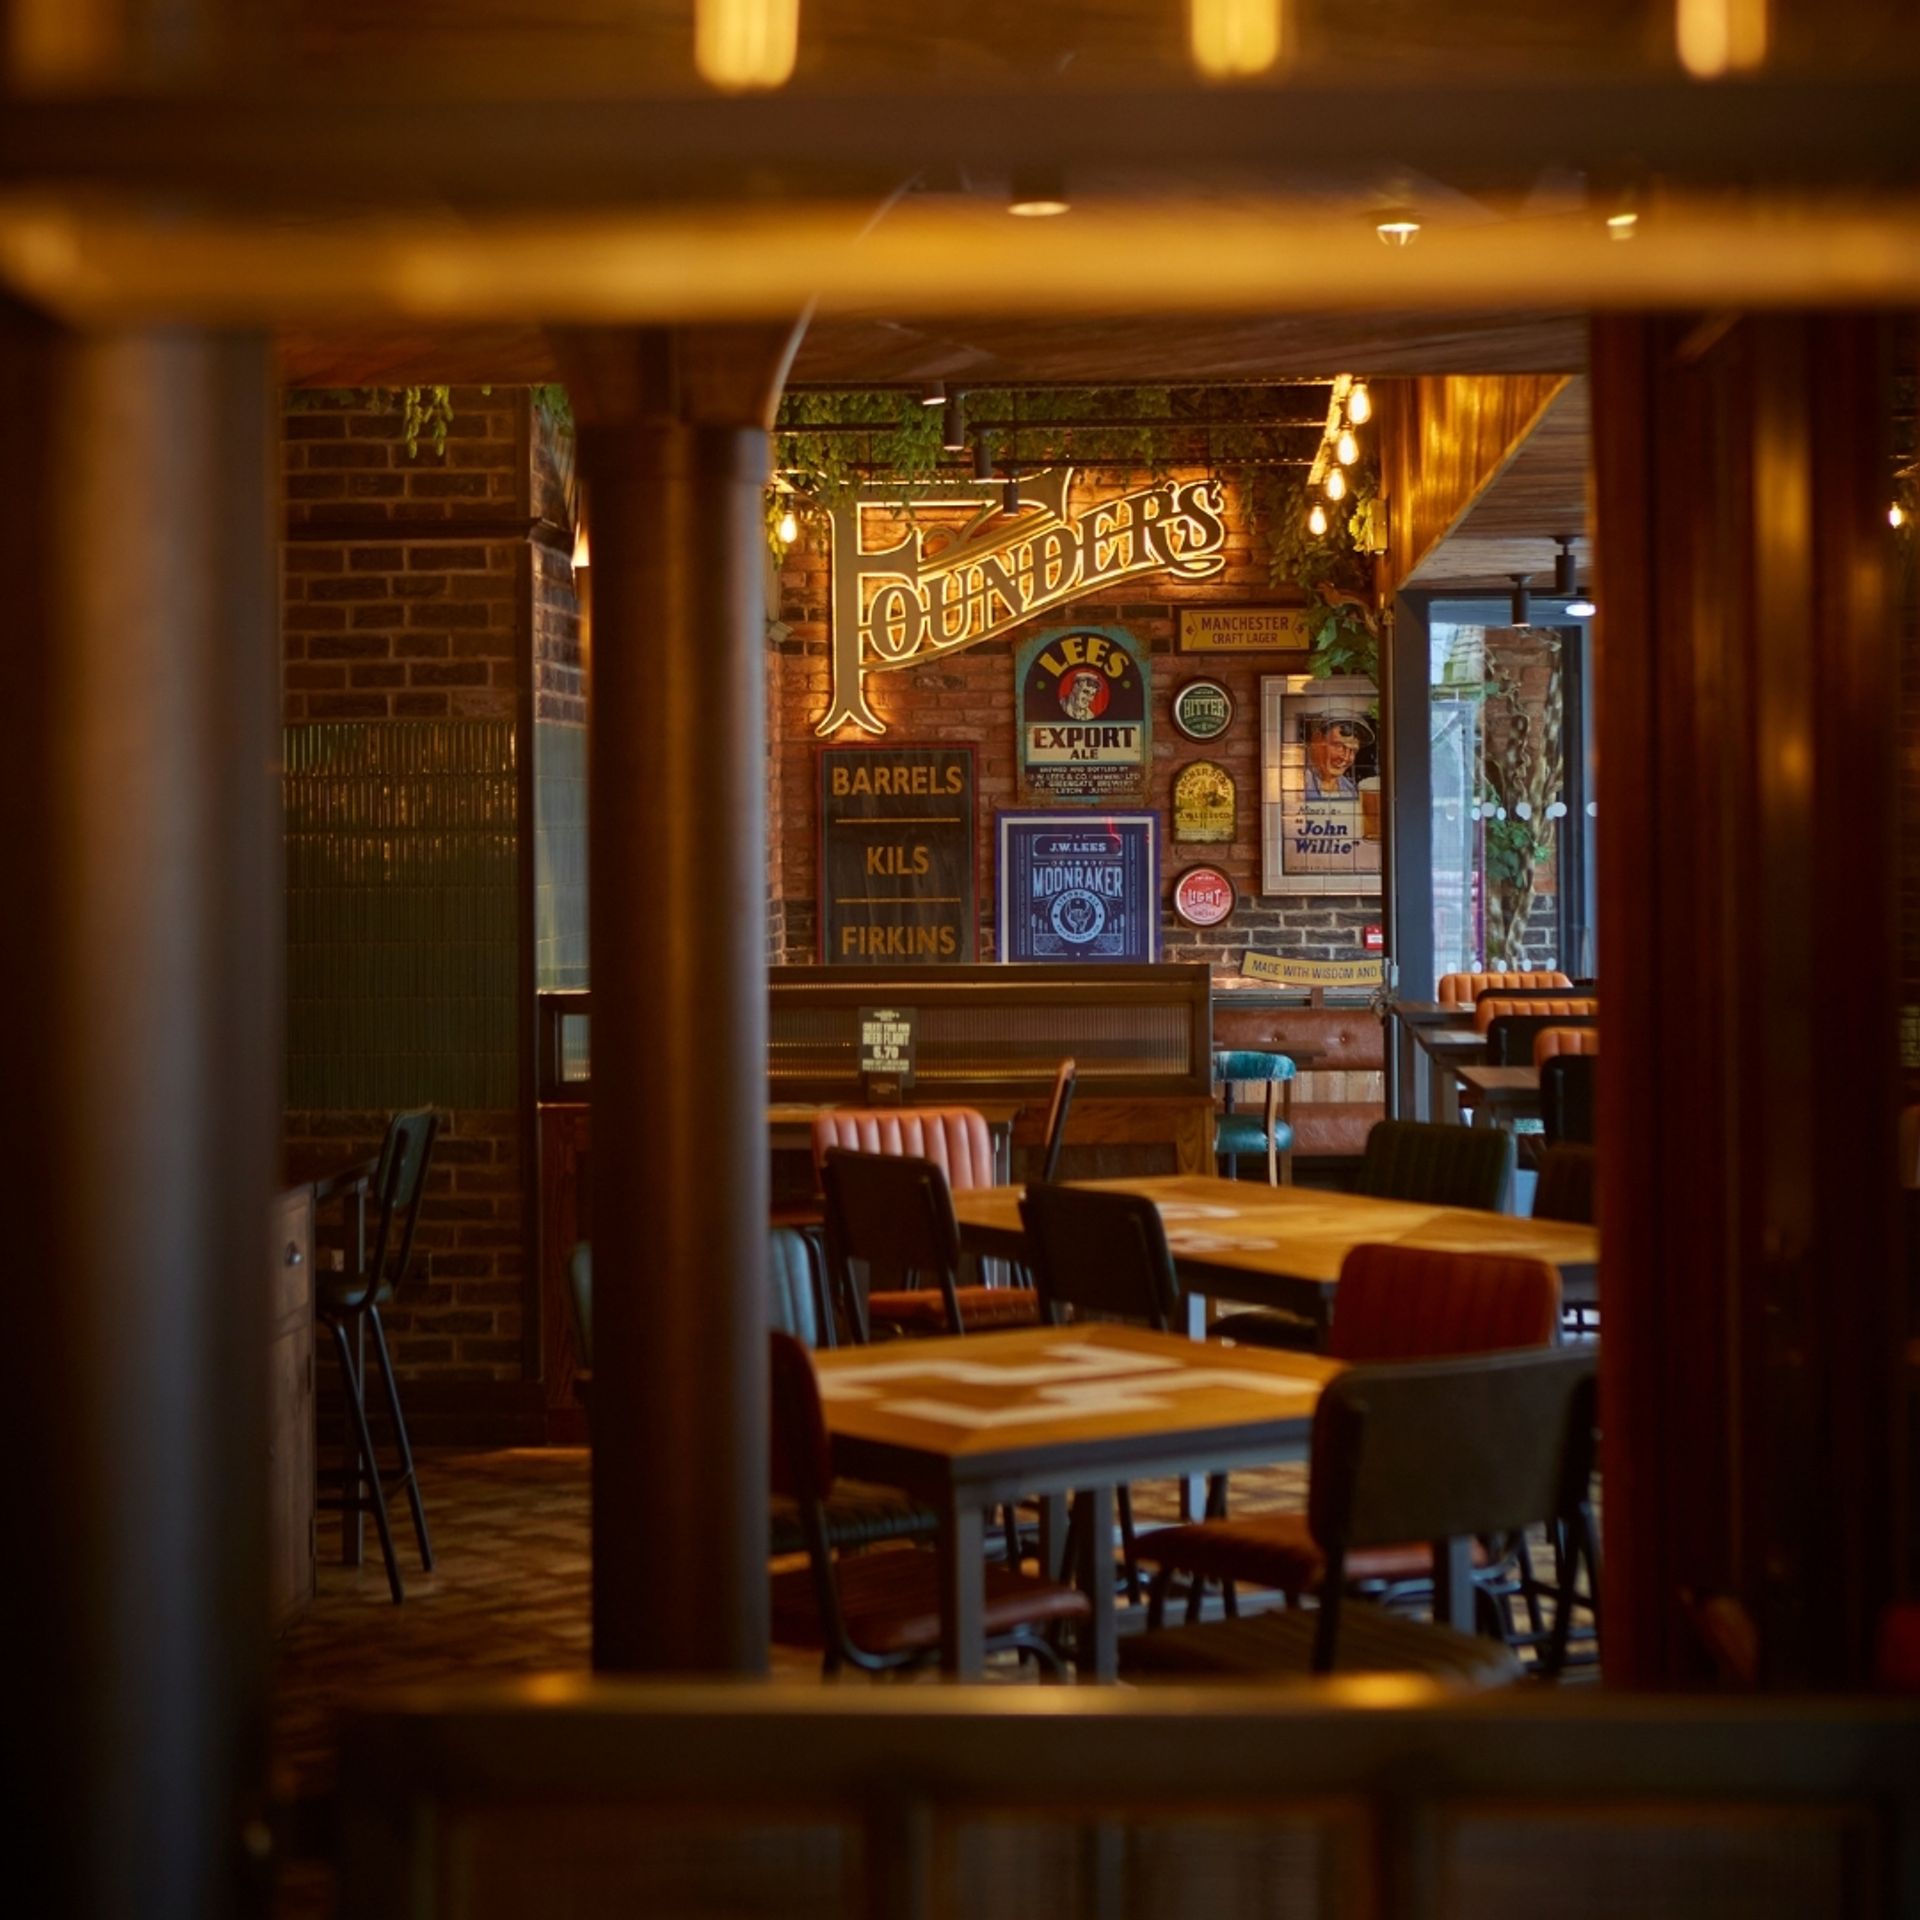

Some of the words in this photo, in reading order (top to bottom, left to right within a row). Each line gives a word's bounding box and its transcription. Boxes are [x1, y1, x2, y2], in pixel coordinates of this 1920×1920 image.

[1201, 616, 1289, 631] MANCHESTER
[1212, 633, 1243, 644] CRAFT
[1246, 633, 1278, 643] LAGER
[1039, 637, 1129, 678] LEES
[1183, 699, 1225, 719] BITTER
[1033, 727, 1136, 749] EXPORT
[1070, 749, 1099, 760] ALE
[832, 766, 963, 795] BARRELS
[867, 847, 929, 875] KILS
[1032, 866, 1123, 897] MOONRAKER
[842, 926, 956, 955] FIRKINS
[1252, 960, 1280, 975] MADE
[1284, 965, 1309, 977] WITH
[1312, 967, 1354, 980] WISDOM
[1357, 967, 1377, 978] AND
